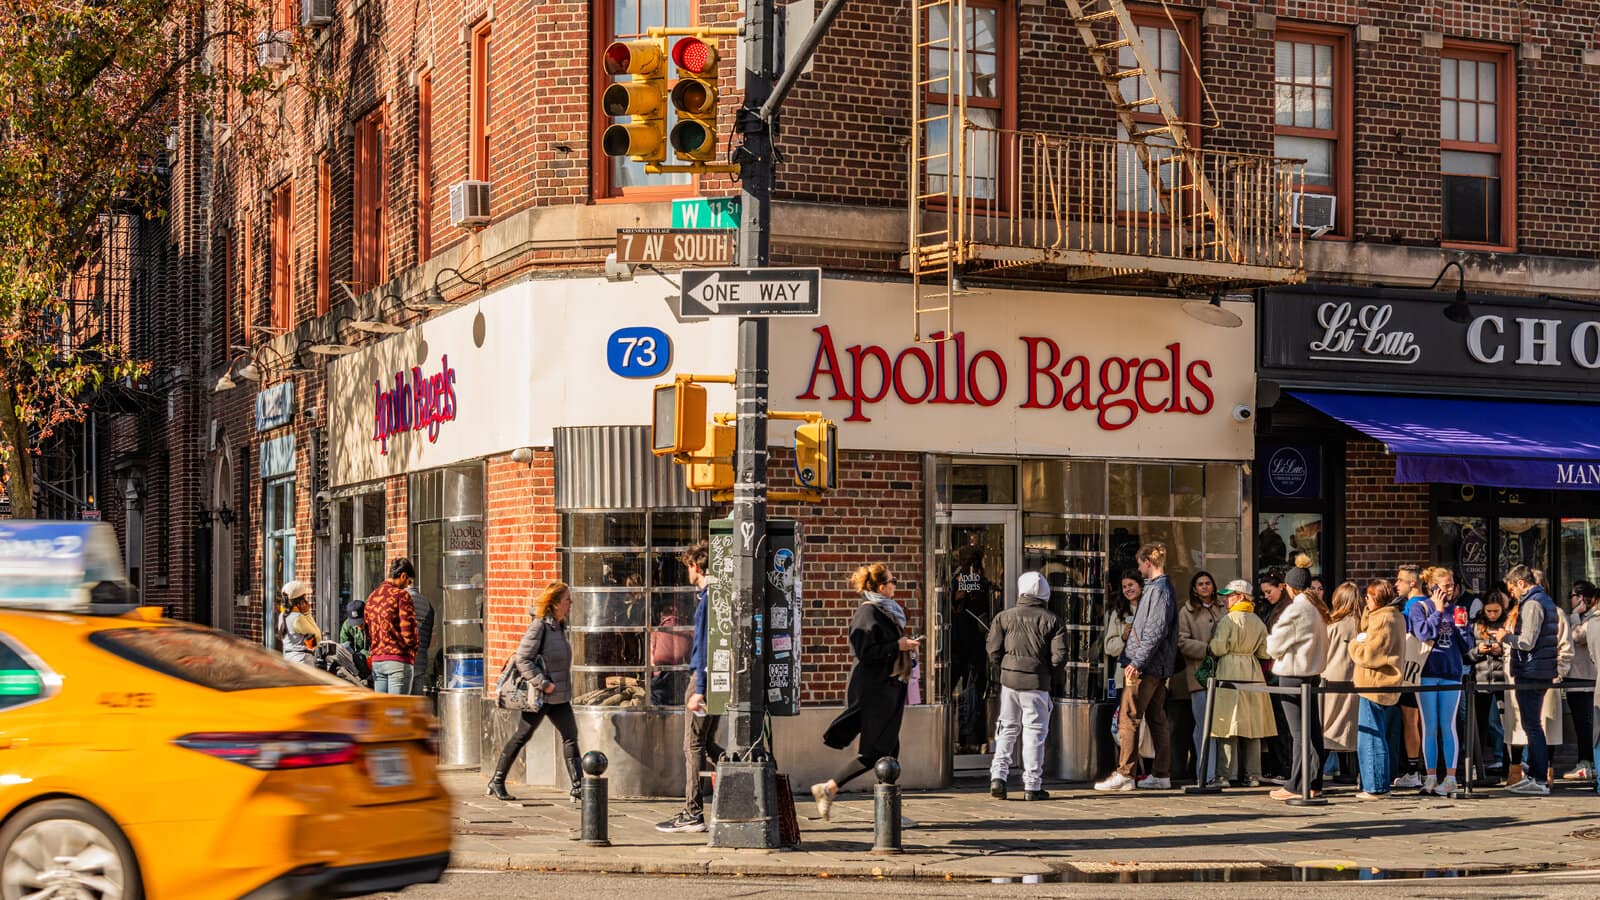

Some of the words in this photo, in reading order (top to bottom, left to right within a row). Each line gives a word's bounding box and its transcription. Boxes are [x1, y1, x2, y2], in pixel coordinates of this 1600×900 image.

[681, 203, 699, 228] W
[710, 202, 723, 228] 11
[622, 235, 634, 261] 7
[642, 235, 664, 261] AV
[673, 235, 728, 261] SOUTH
[702, 284, 740, 301] ONE
[760, 283, 800, 301] WAY
[618, 336, 656, 367] 73
[796, 324, 1008, 422] Apollo
[1018, 336, 1214, 431] Bagels
[372, 379, 413, 455] Apollo
[411, 353, 457, 444] Bagels
[1556, 463, 1600, 484] MAN
[449, 525, 482, 539] Apollo
[450, 538, 482, 550] Bagels
[958, 582, 981, 593] Bagels
[959, 573, 981, 584] Apollo
